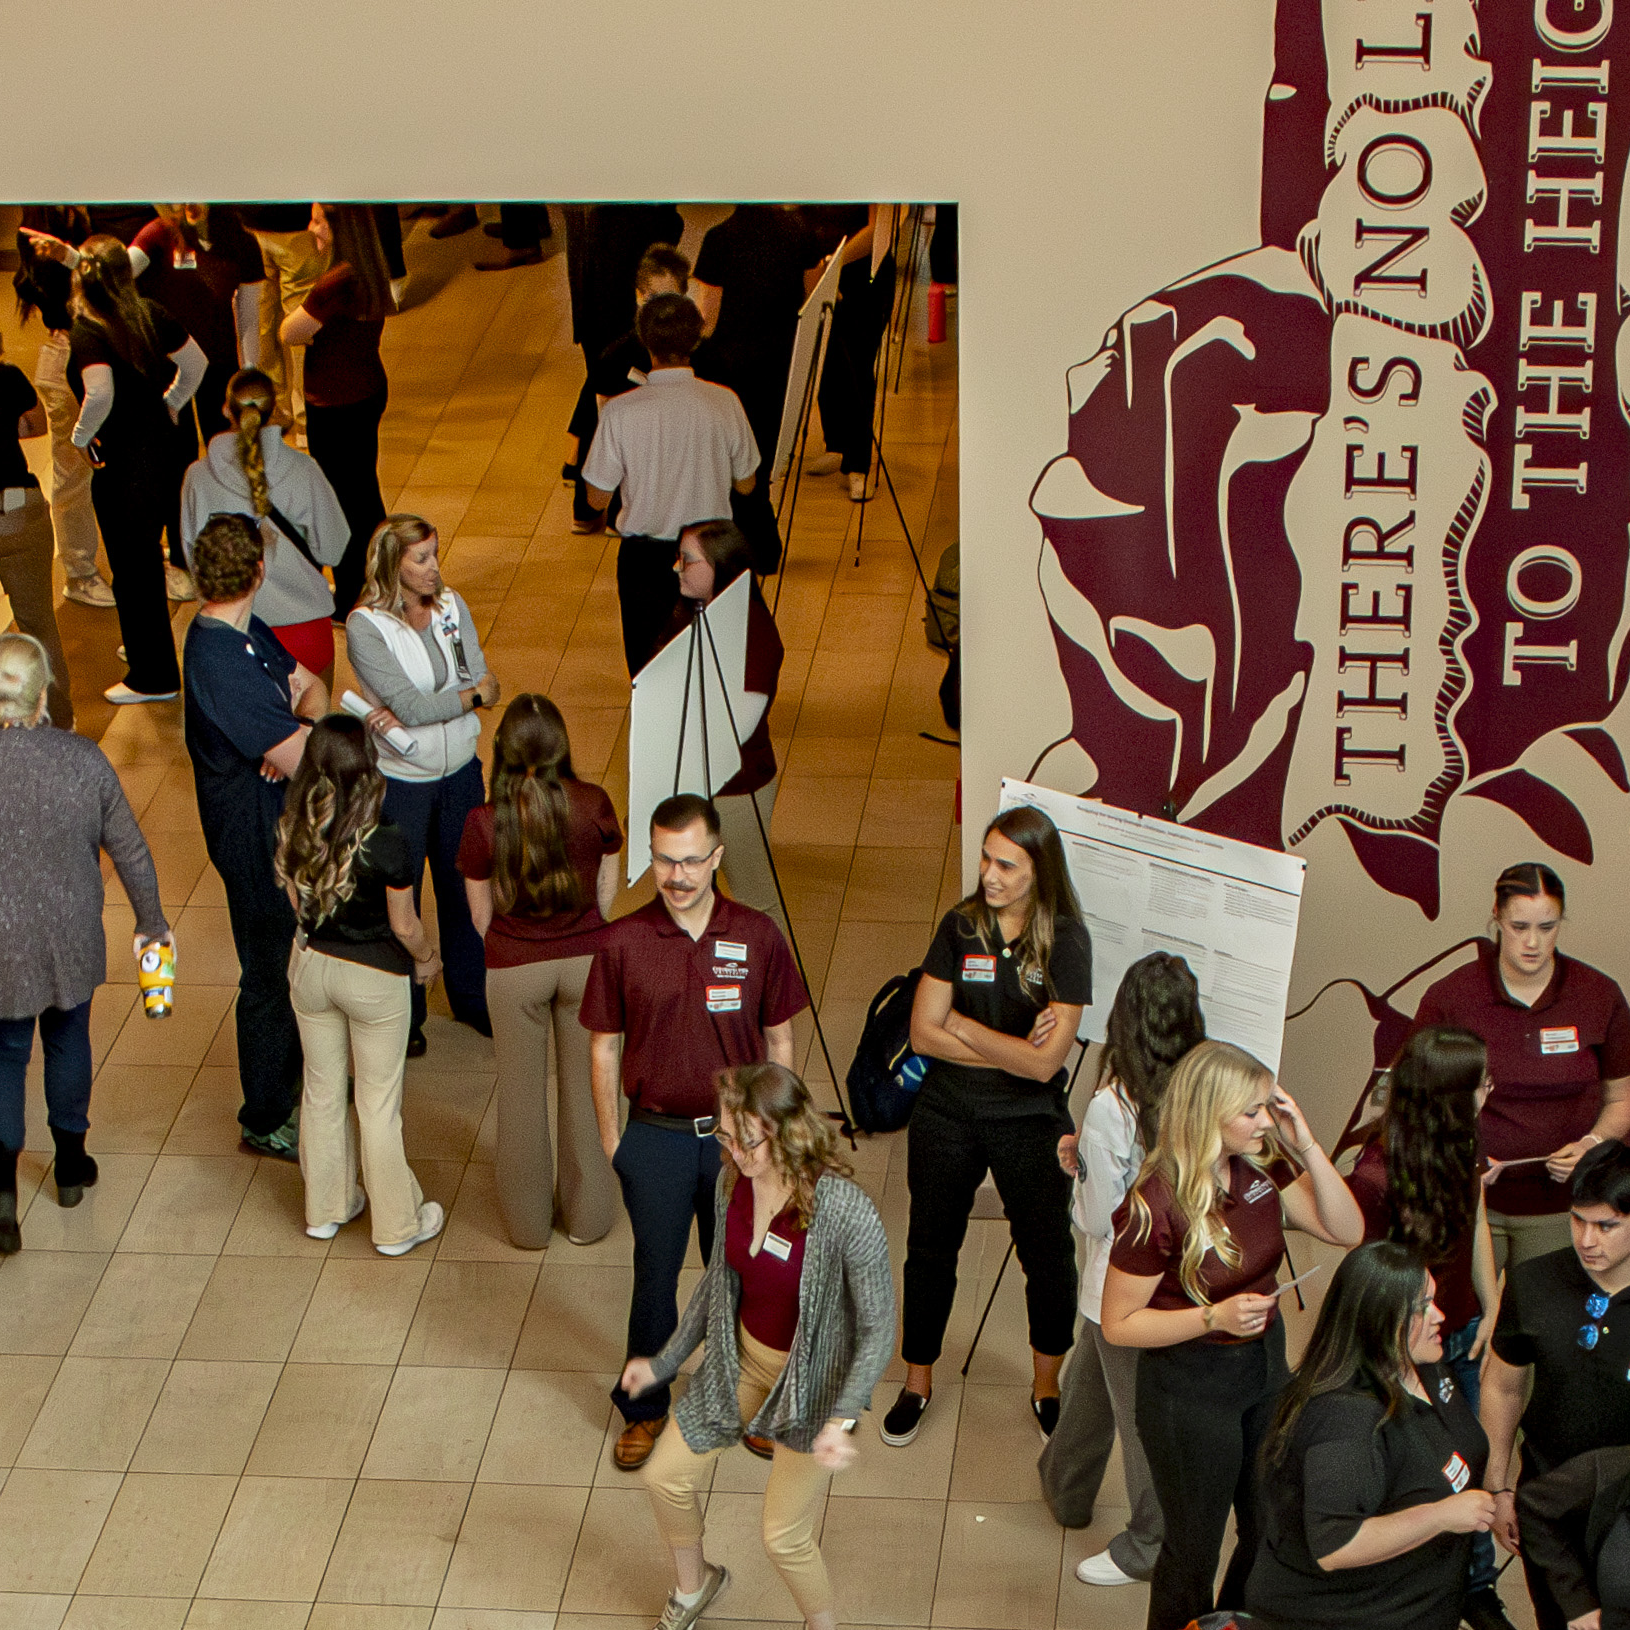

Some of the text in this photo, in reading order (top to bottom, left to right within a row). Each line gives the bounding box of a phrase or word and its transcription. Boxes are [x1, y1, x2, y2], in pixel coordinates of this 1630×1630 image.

[1334, 0, 1433, 786] THERE'S NO L
[1511, 290, 1598, 510] THE
[1502, 544, 1583, 686] TO
